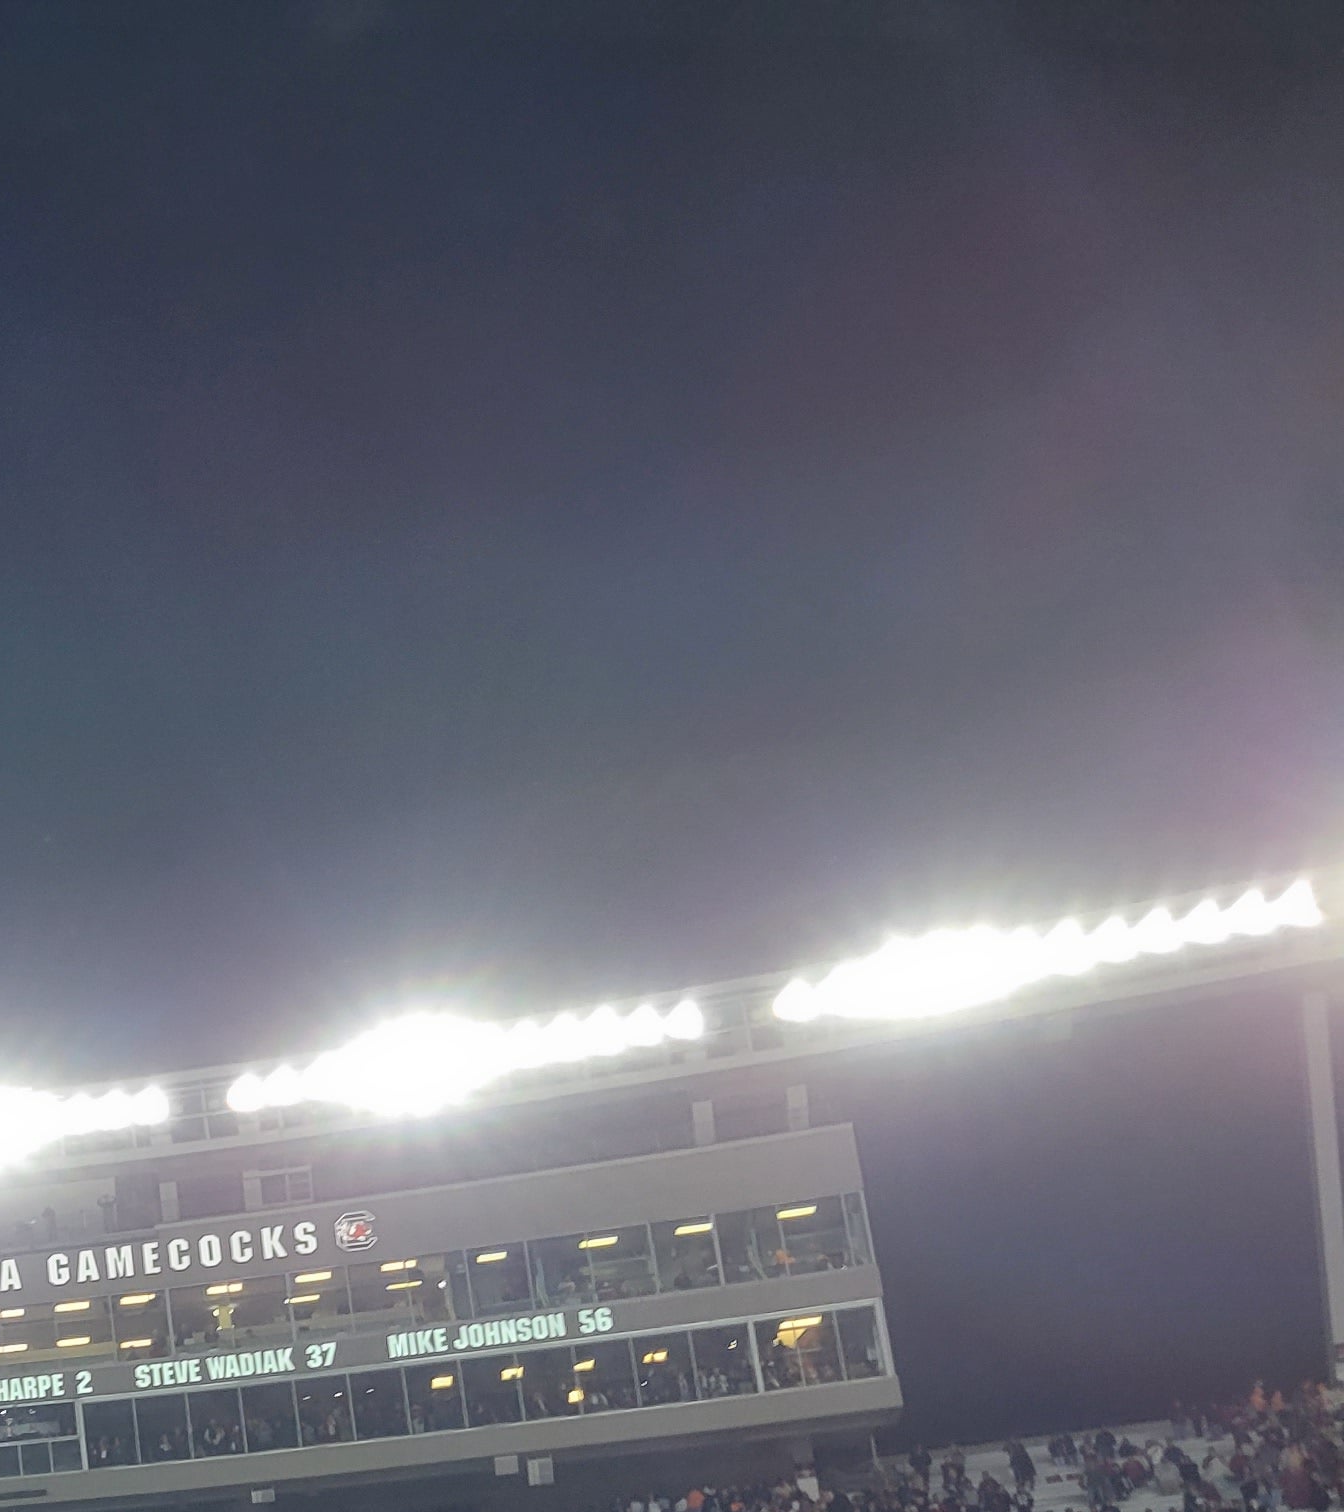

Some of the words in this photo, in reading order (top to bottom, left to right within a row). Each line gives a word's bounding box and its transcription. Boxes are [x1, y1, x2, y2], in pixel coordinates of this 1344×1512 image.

[48, 1221, 318, 1287] GAMECOCKS
[387, 1326, 450, 1359] MIKE
[452, 1311, 568, 1351] JOHNSON
[578, 1307, 614, 1334] 56
[76, 1371, 94, 1395] 2
[135, 1357, 202, 1390] STEVE
[206, 1347, 296, 1382] WADIAK
[306, 1341, 337, 1369] 37
